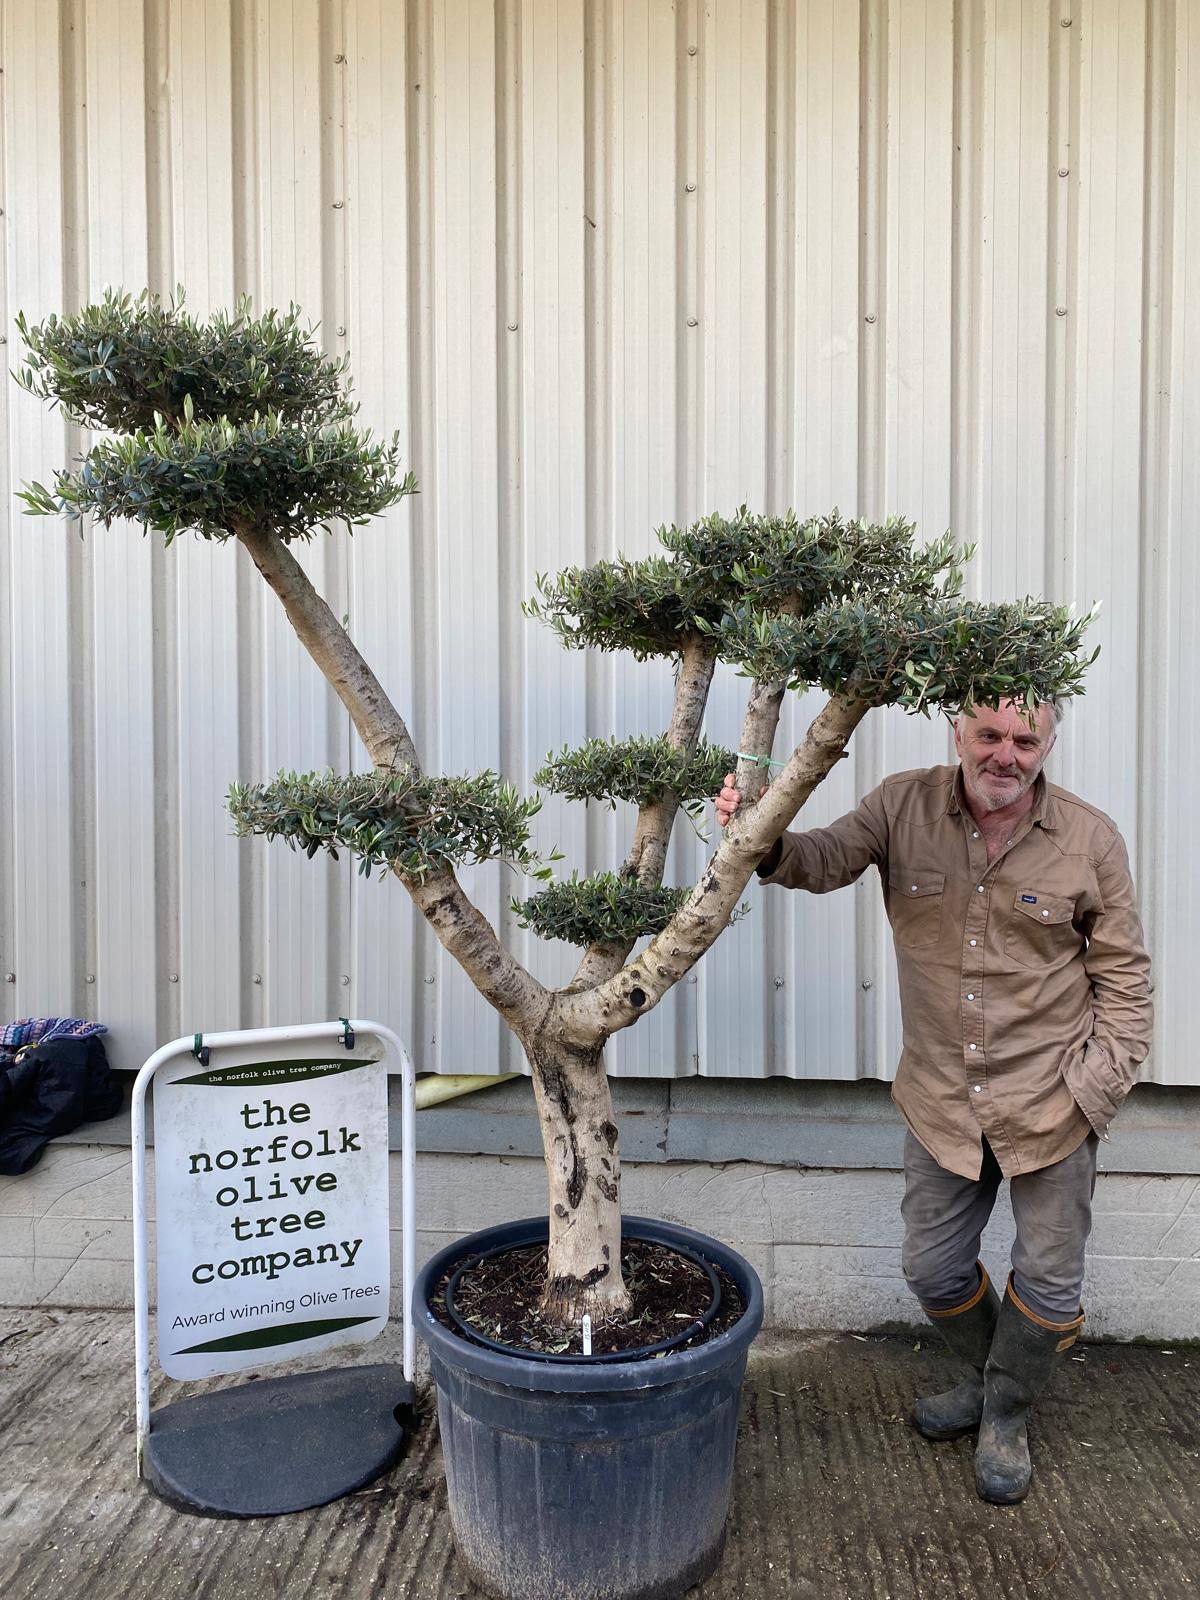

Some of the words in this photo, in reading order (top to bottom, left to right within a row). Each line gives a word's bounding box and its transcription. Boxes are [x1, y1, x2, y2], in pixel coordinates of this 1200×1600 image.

[208, 1075, 223, 1083] the
[226, 1071, 259, 1081] norfolk
[262, 1068, 286, 1077] olive
[289, 1066, 307, 1074] tree
[310, 1062, 342, 1071] company
[240, 1100, 310, 1129] the
[189, 1127, 361, 1174] norfolk
[217, 1173, 337, 1206] olive
[231, 1210, 325, 1241] tree
[192, 1239, 362, 1284] company
[172, 1308, 224, 1329] Award
[230, 1300, 294, 1319] winning
[300, 1292, 337, 1307] Olive
[342, 1286, 380, 1300] Trees
